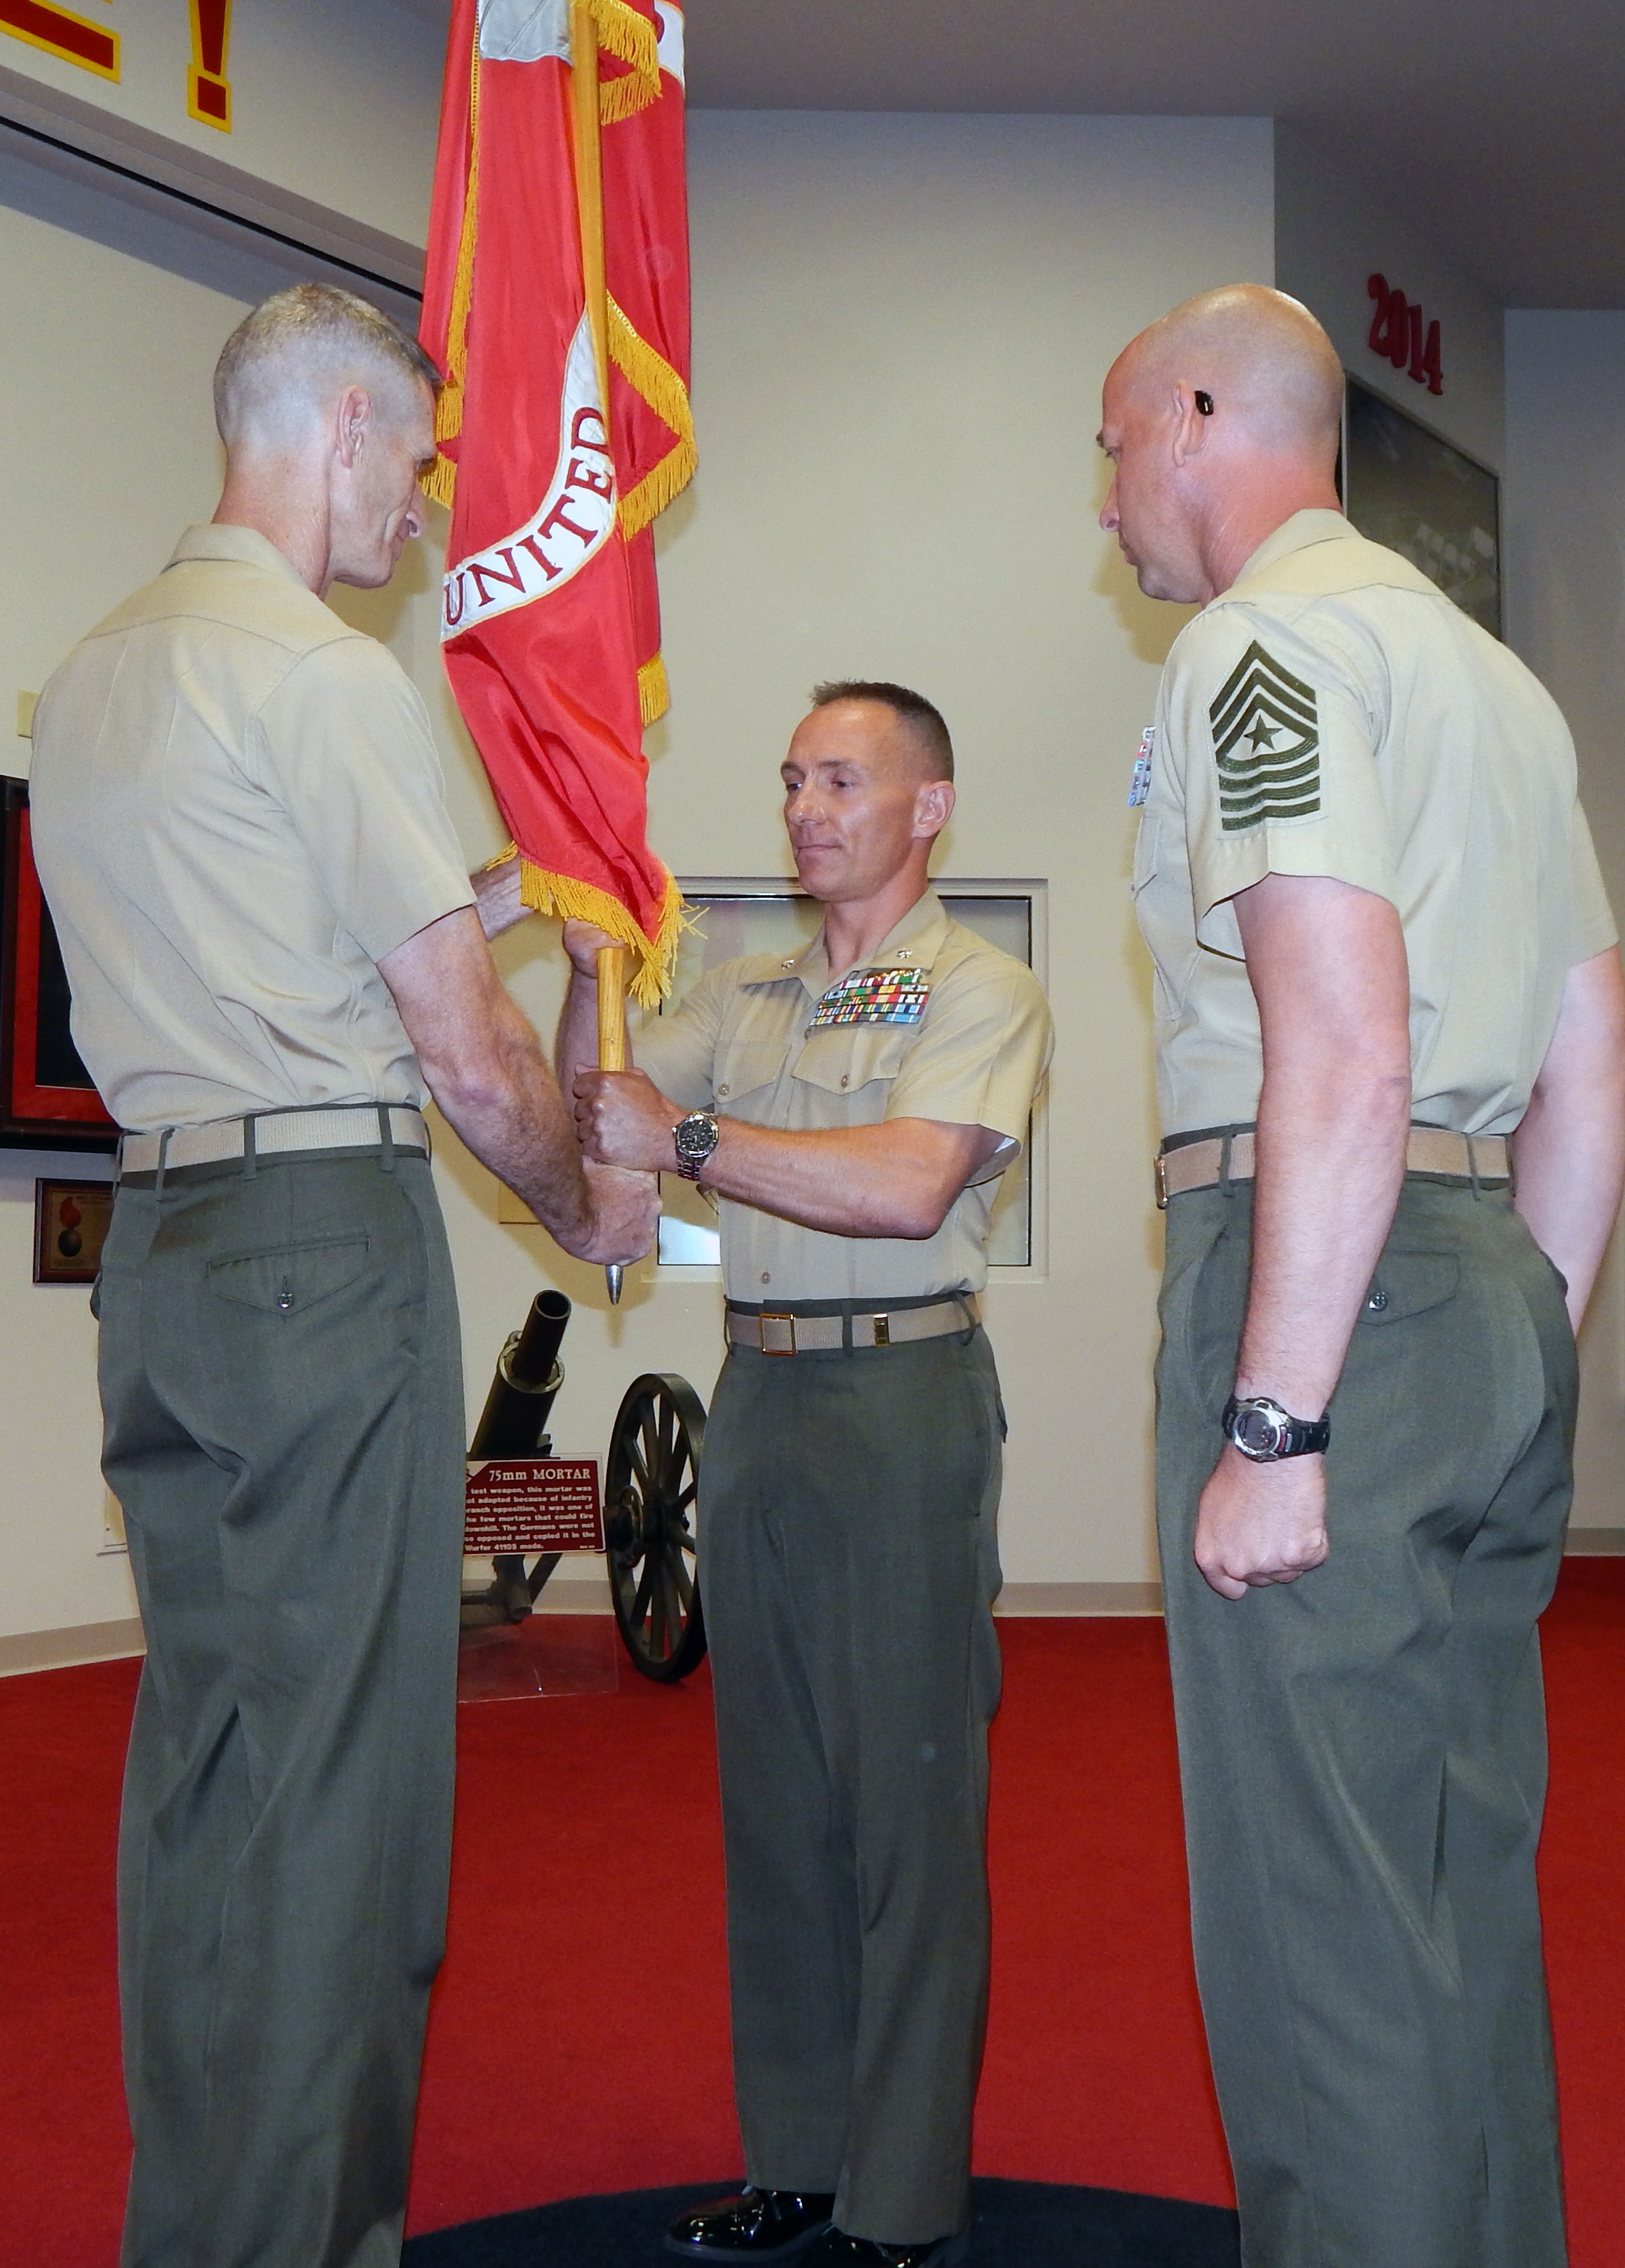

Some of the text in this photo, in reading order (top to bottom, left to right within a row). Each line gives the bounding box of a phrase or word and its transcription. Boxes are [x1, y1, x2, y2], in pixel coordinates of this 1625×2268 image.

[1368, 273, 1444, 396] 2014
[444, 406, 612, 626] UNITED
[488, 1468, 591, 1482] 75mm MORTAR
